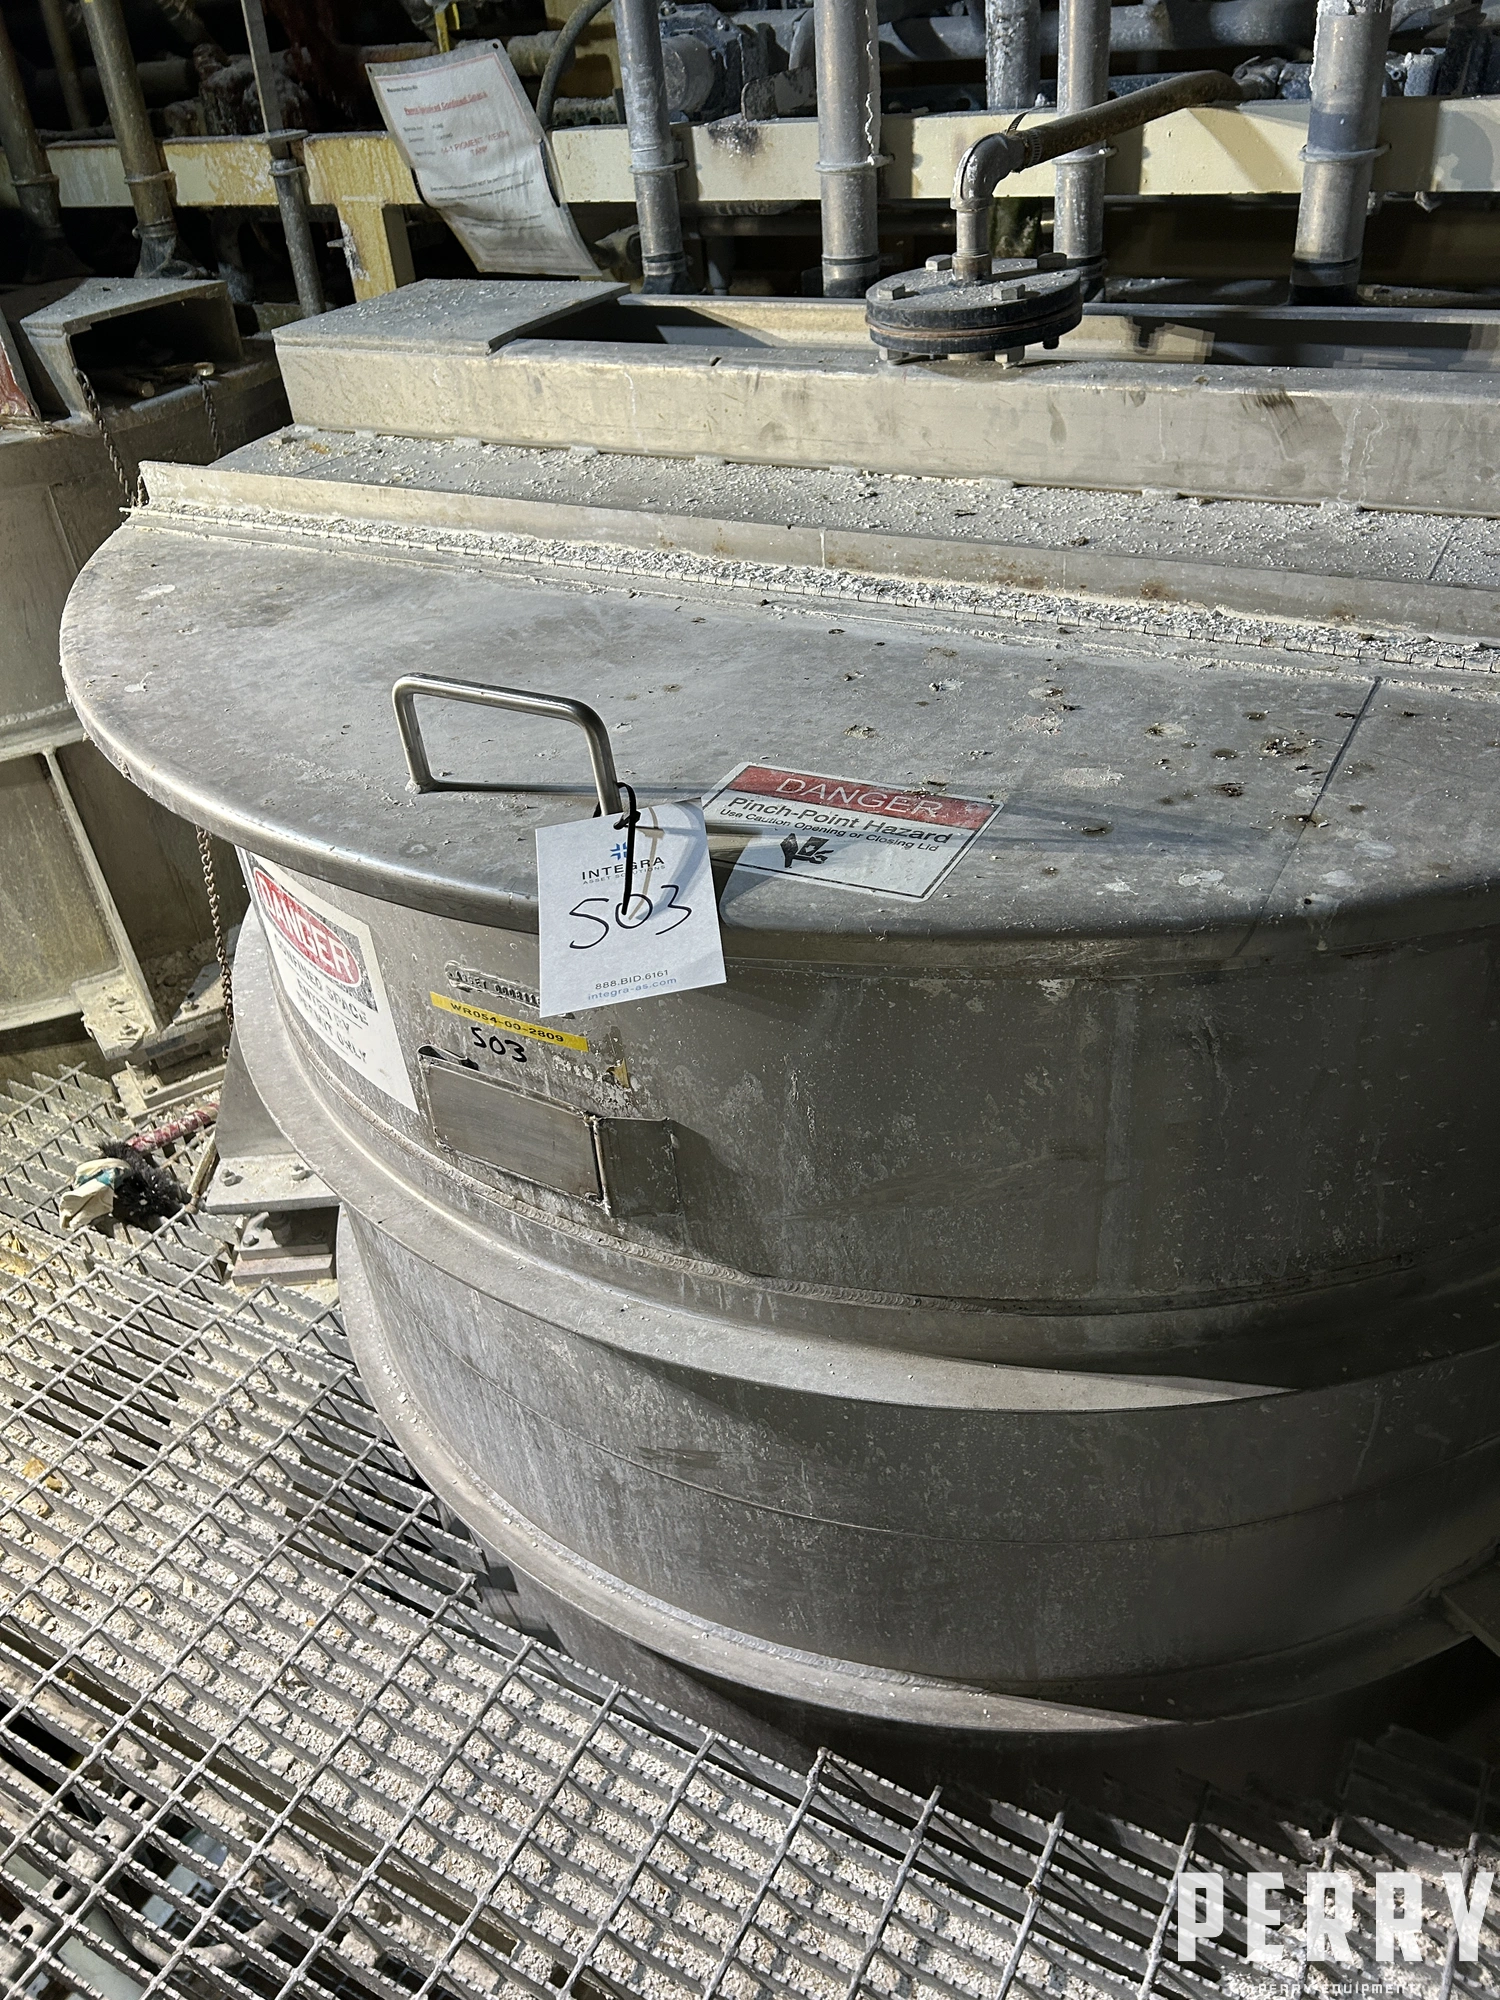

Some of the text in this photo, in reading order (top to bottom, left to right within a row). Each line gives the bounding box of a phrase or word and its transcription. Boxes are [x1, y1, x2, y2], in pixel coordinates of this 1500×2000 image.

[776, 778, 944, 818] DANGER
[720, 808, 939, 852] Use Caution Opening or Closing Lid
[728, 797, 953, 844] Pinch-Point Hazard
[583, 865, 666, 885] ASSET SOUTIONS
[258, 875, 356, 983] DANGER
[569, 884, 692, 949] 503
[588, 977, 677, 1001] integra-as.com
[595, 969, 669, 990] 888.BID.6161
[325, 985, 369, 1026] SPACE
[450, 1002, 565, 1043] WR054-00-2809
[471, 1026, 528, 1063] 503
